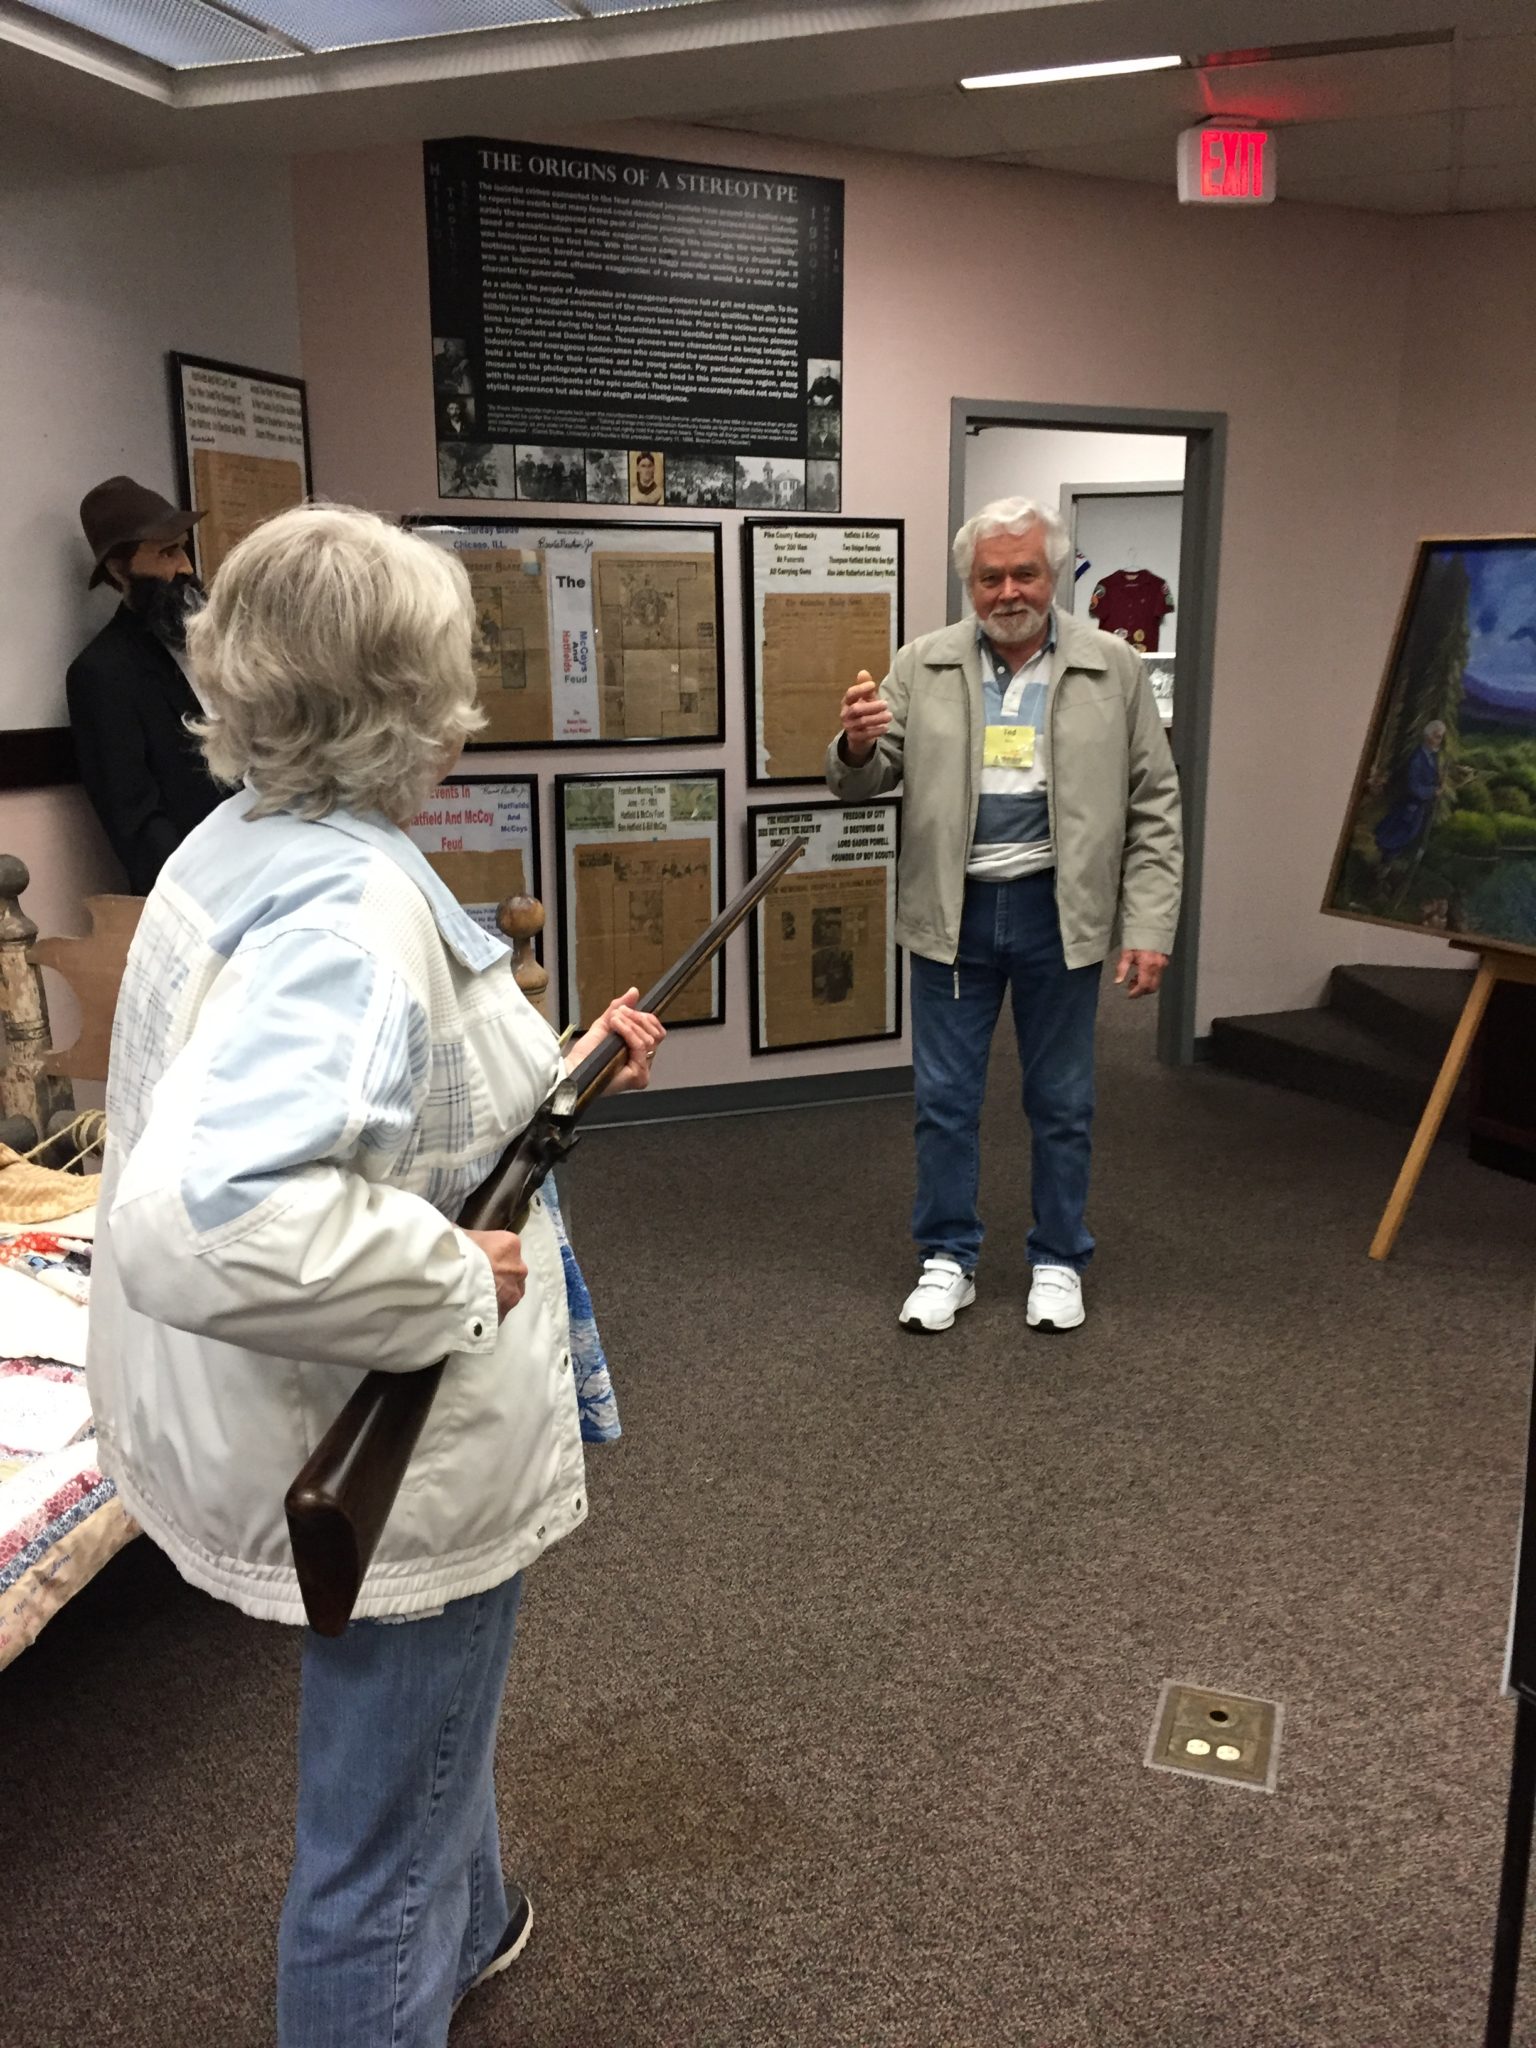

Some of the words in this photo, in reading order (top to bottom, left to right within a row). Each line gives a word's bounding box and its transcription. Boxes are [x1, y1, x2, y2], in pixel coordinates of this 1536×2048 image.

[1201, 129, 1268, 197] EXIT
[477, 150, 522, 172] THE
[528, 156, 616, 182] ORIGINS
[623, 166, 649, 186] OF
[655, 170, 669, 189] A
[675, 173, 798, 203] STEREOTYPE
[776, 531, 793, 541] County
[794, 531, 817, 541] Kentucky
[555, 575, 586, 588] The
[562, 630, 572, 673] Hatfields
[572, 641, 581, 663] And
[580, 631, 588, 673] McCoys
[564, 674, 588, 684] Feud
[430, 784, 459, 800] vents
[461, 784, 471, 799] In
[498, 801, 530, 811] Hatfields
[410, 809, 443, 827] atfield
[445, 810, 462, 825] And
[464, 808, 494, 827] McCoy
[507, 813, 521, 822] And
[842, 810, 866, 821] FREEDOM
[500, 825, 528, 834] McCoys
[441, 836, 463, 851] Feud
